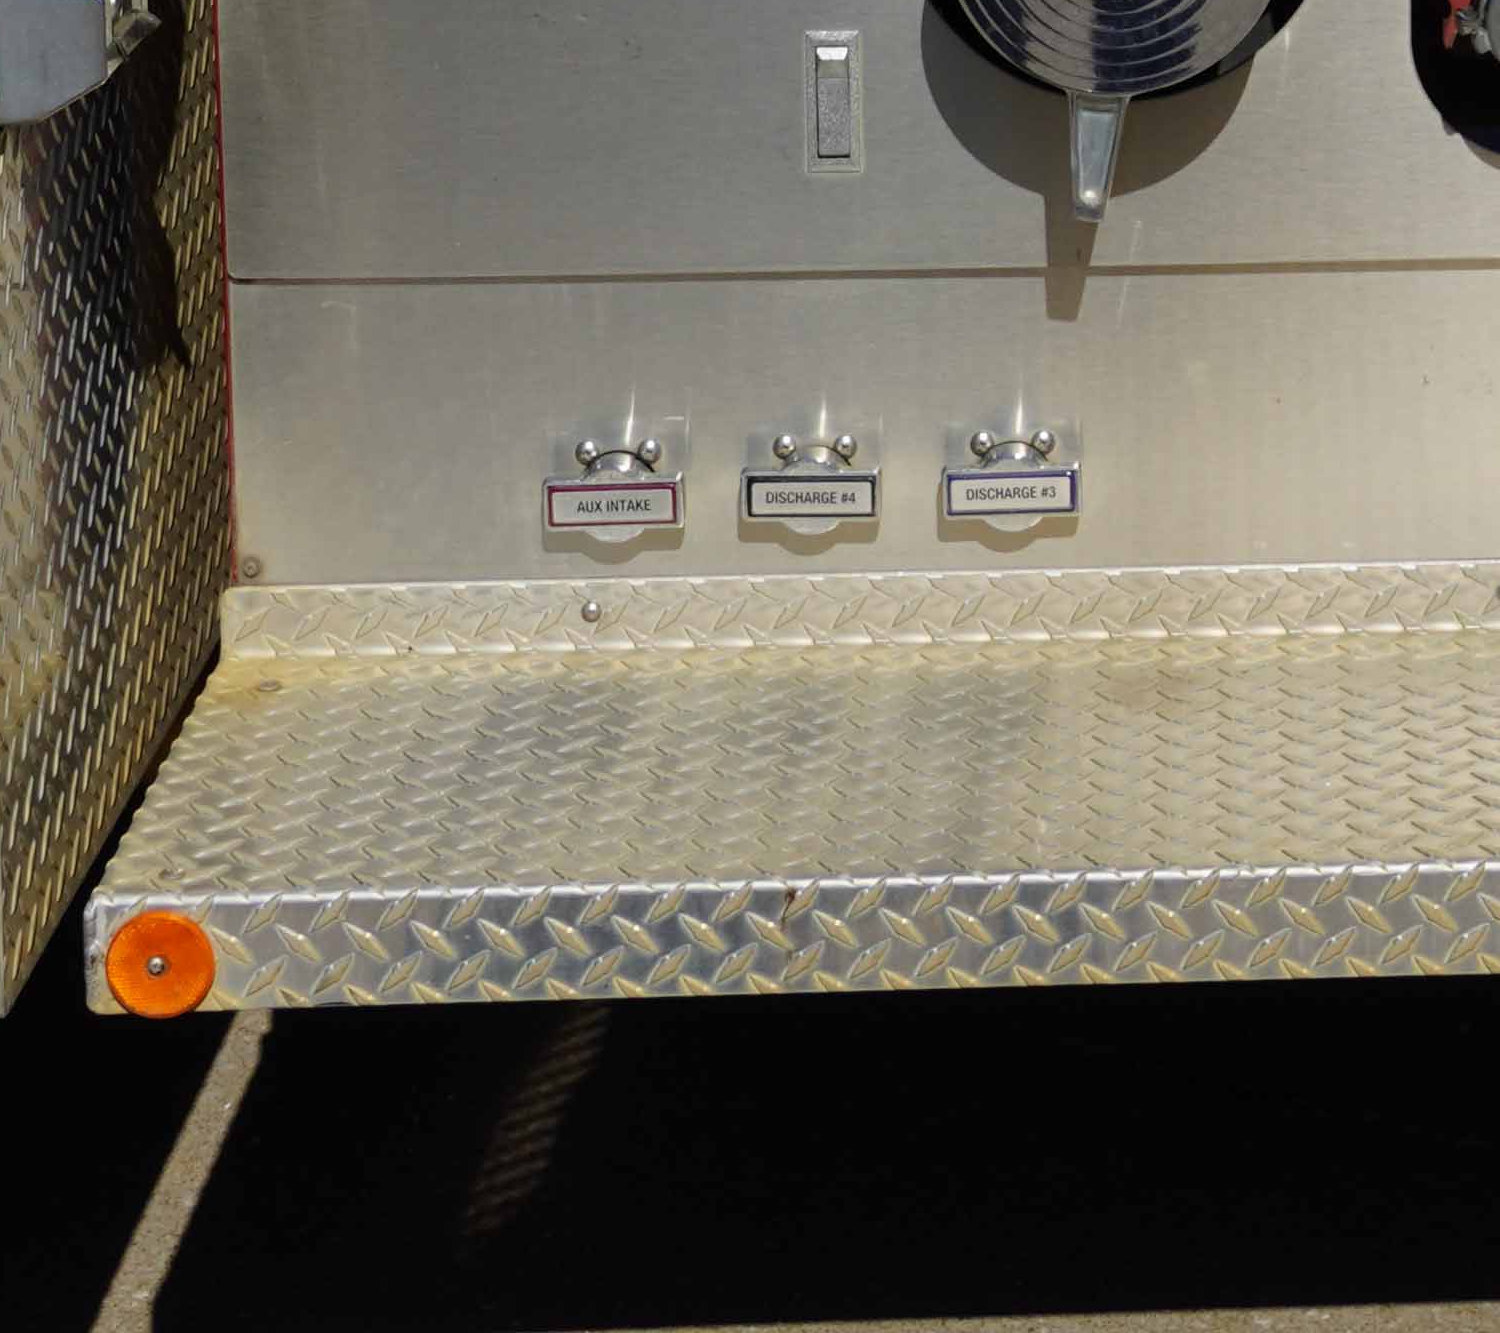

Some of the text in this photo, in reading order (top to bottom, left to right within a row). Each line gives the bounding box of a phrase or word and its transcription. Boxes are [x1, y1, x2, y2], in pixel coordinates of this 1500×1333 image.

[765, 490, 857, 505] DISCHARGE #4
[966, 486, 1057, 501] DISCHARGE #3
[576, 499, 652, 513] AUX INTAKE
